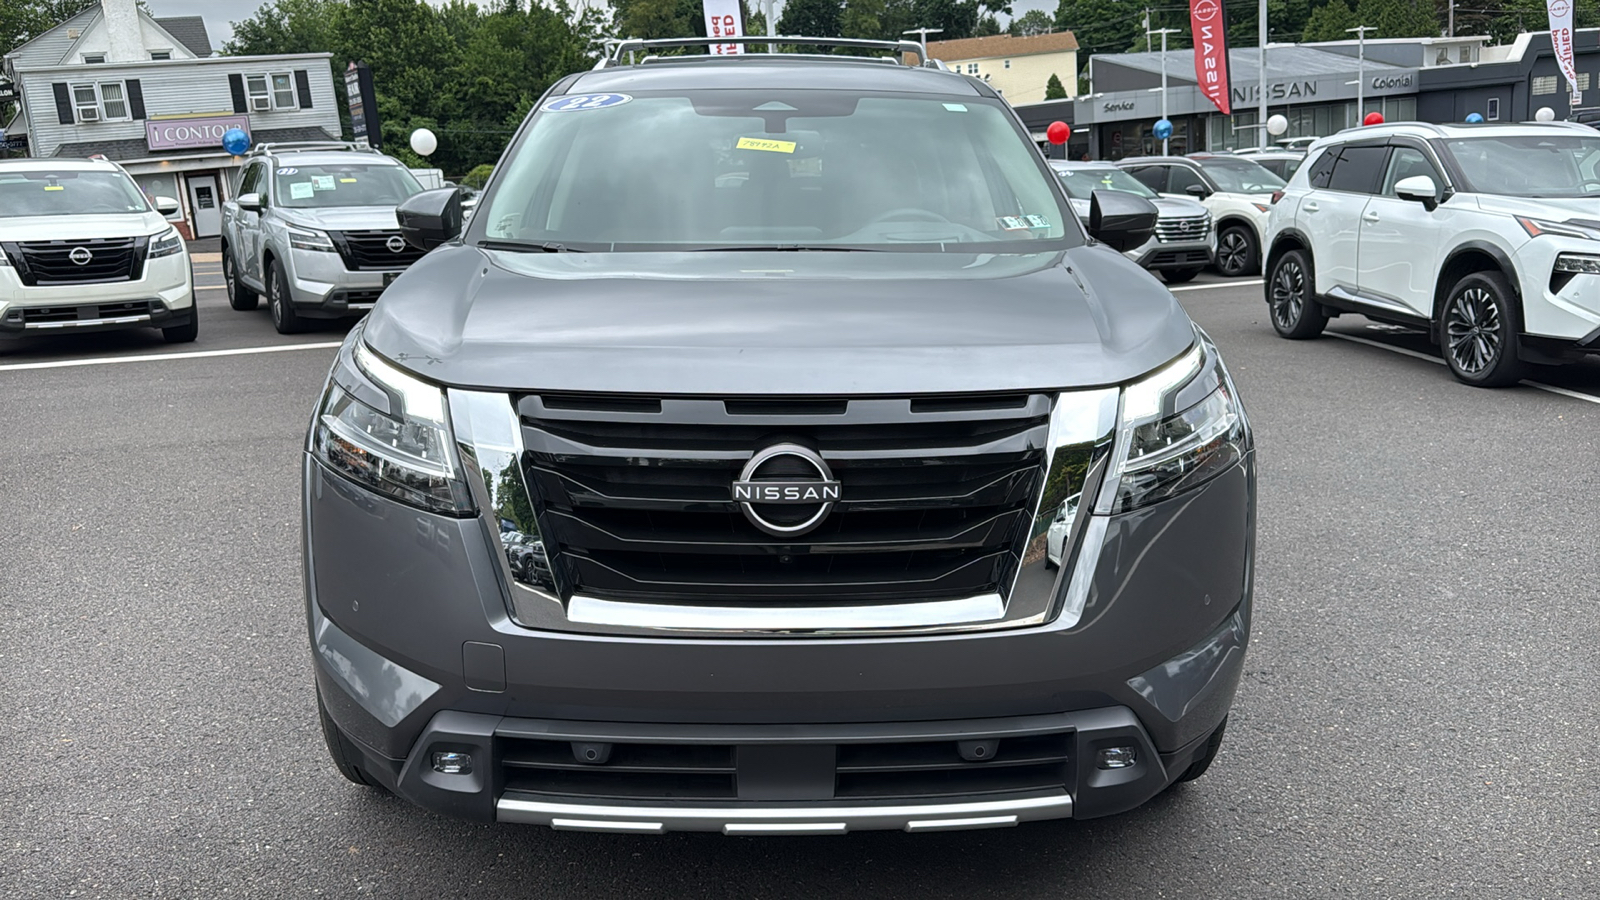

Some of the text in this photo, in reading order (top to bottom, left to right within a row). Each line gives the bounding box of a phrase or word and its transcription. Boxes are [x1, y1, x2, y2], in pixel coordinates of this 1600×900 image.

[1372, 75, 1413, 89] Colonial
[1233, 81, 1317, 102] NISSAN
[560, 95, 610, 110] 22
[1103, 101, 1135, 113] Service
[164, 124, 242, 141] CONTO
[735, 485, 839, 500] NISSAN
